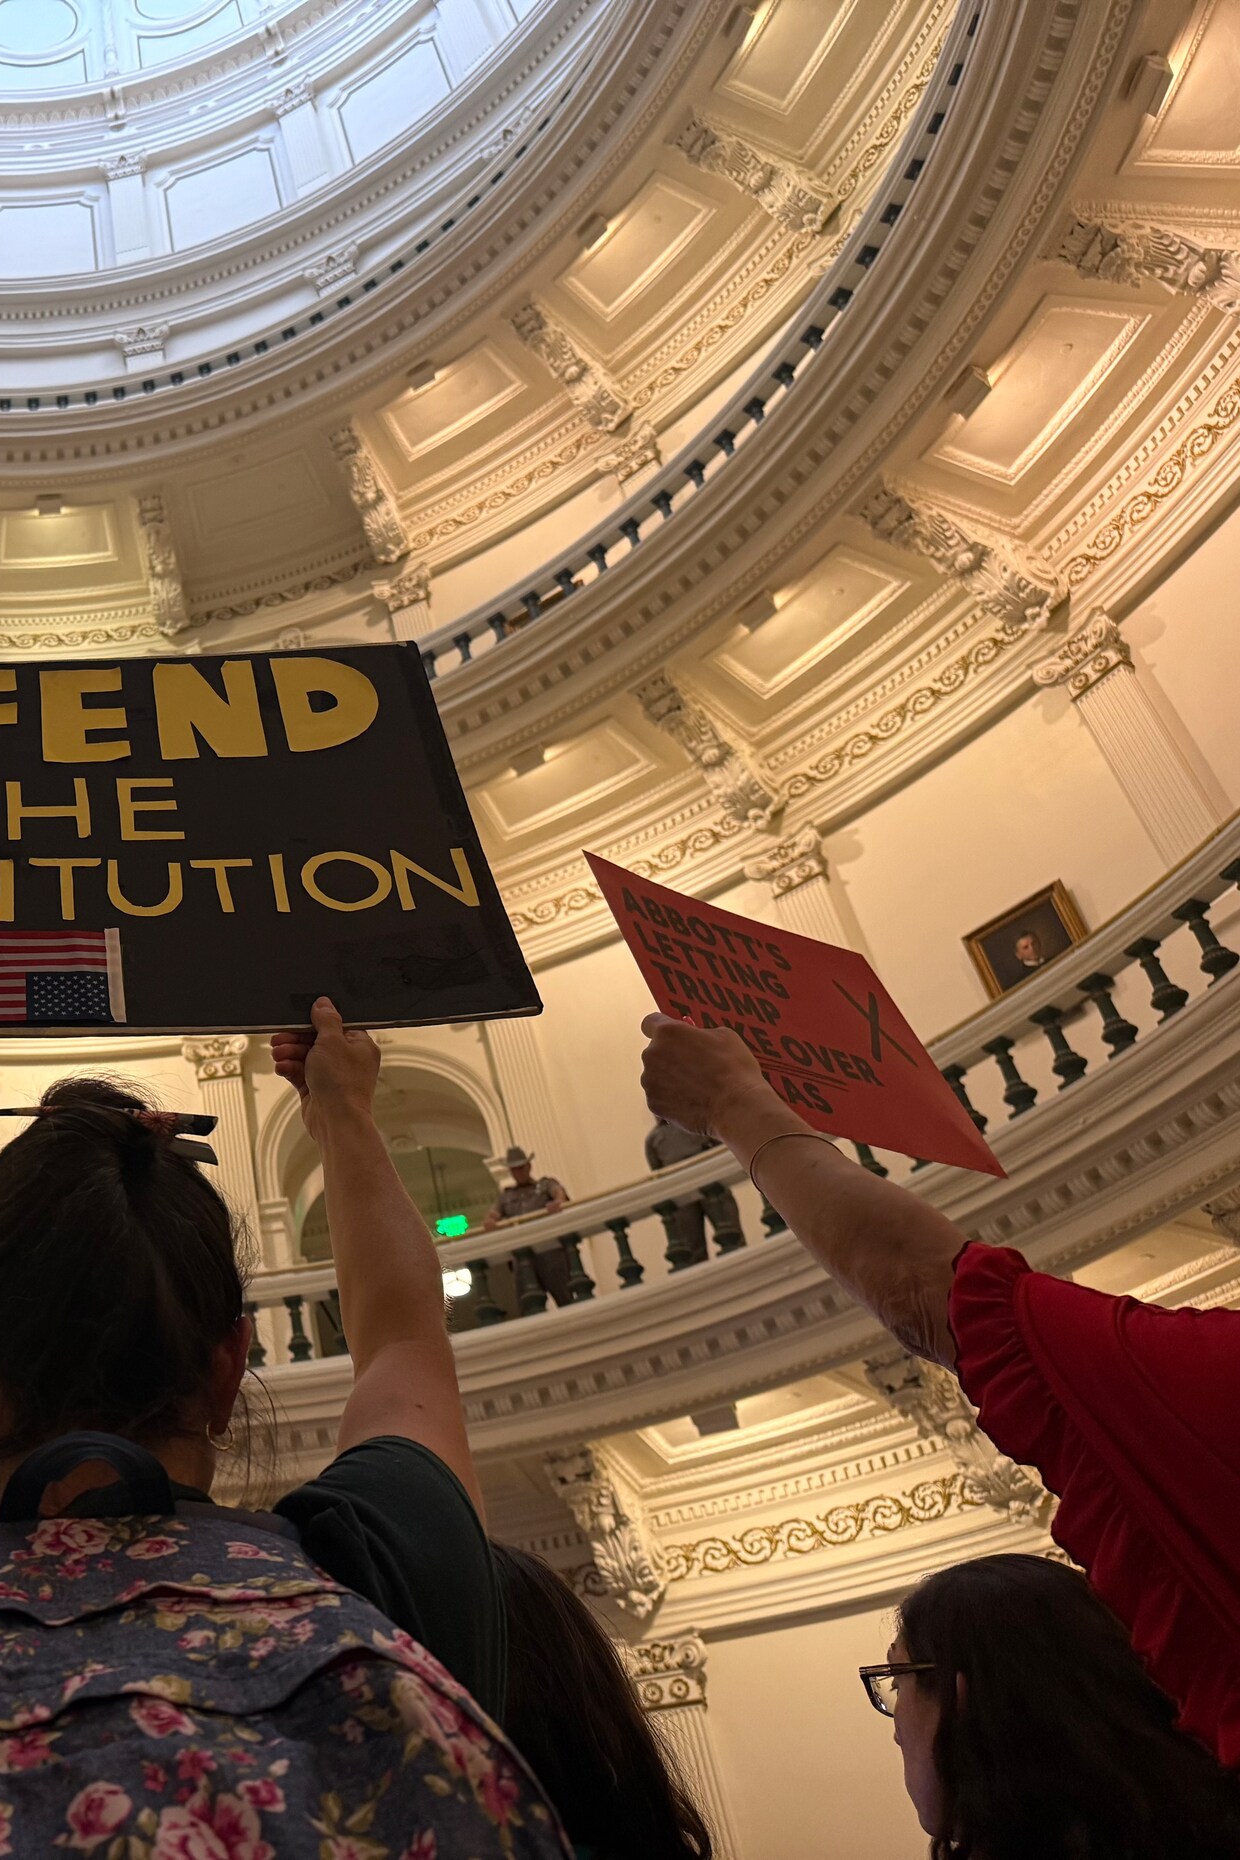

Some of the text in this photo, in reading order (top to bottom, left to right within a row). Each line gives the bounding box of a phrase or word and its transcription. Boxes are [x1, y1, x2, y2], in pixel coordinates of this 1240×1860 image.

[622, 886, 792, 972] ABBOTT'S
[633, 921, 791, 1000] LETTING
[650, 959, 781, 1027] TRUMP
[780, 1034, 885, 1087] OVER
